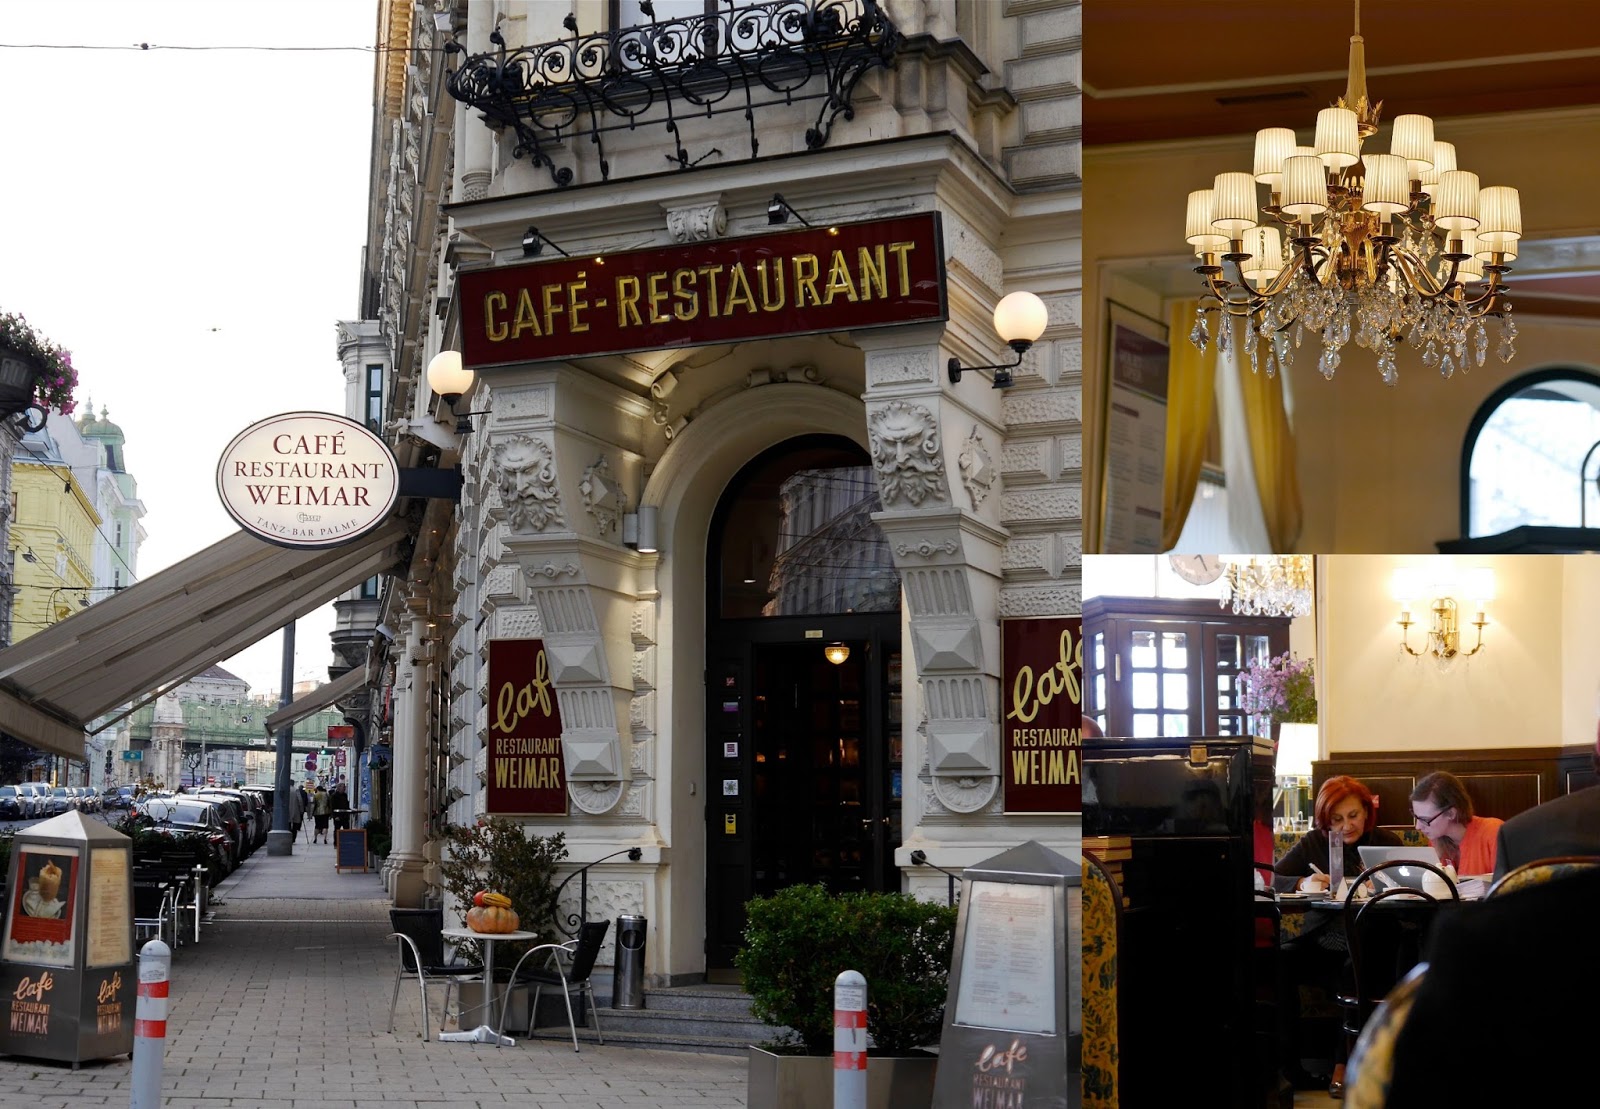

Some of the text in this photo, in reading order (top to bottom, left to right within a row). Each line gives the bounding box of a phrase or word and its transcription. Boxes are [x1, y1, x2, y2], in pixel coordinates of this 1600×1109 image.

[273, 431, 346, 455] CAFÉ
[234, 461, 384, 479] RESTAURANT
[245, 484, 371, 507] WEIMAR
[256, 516, 358, 537] TANZ-BAR PALME
[491, 649, 553, 734] Caf
[496, 738, 561, 755] RESTAURANT
[1013, 728, 1082, 747] RESTAURAN
[495, 757, 561, 789] WEIMAR
[1012, 750, 1082, 785] WEIMA
[13, 971, 53, 1002] Café
[11, 1001, 50, 1015] RESTAURANT
[10, 1011, 48, 1035] WEIMAR
